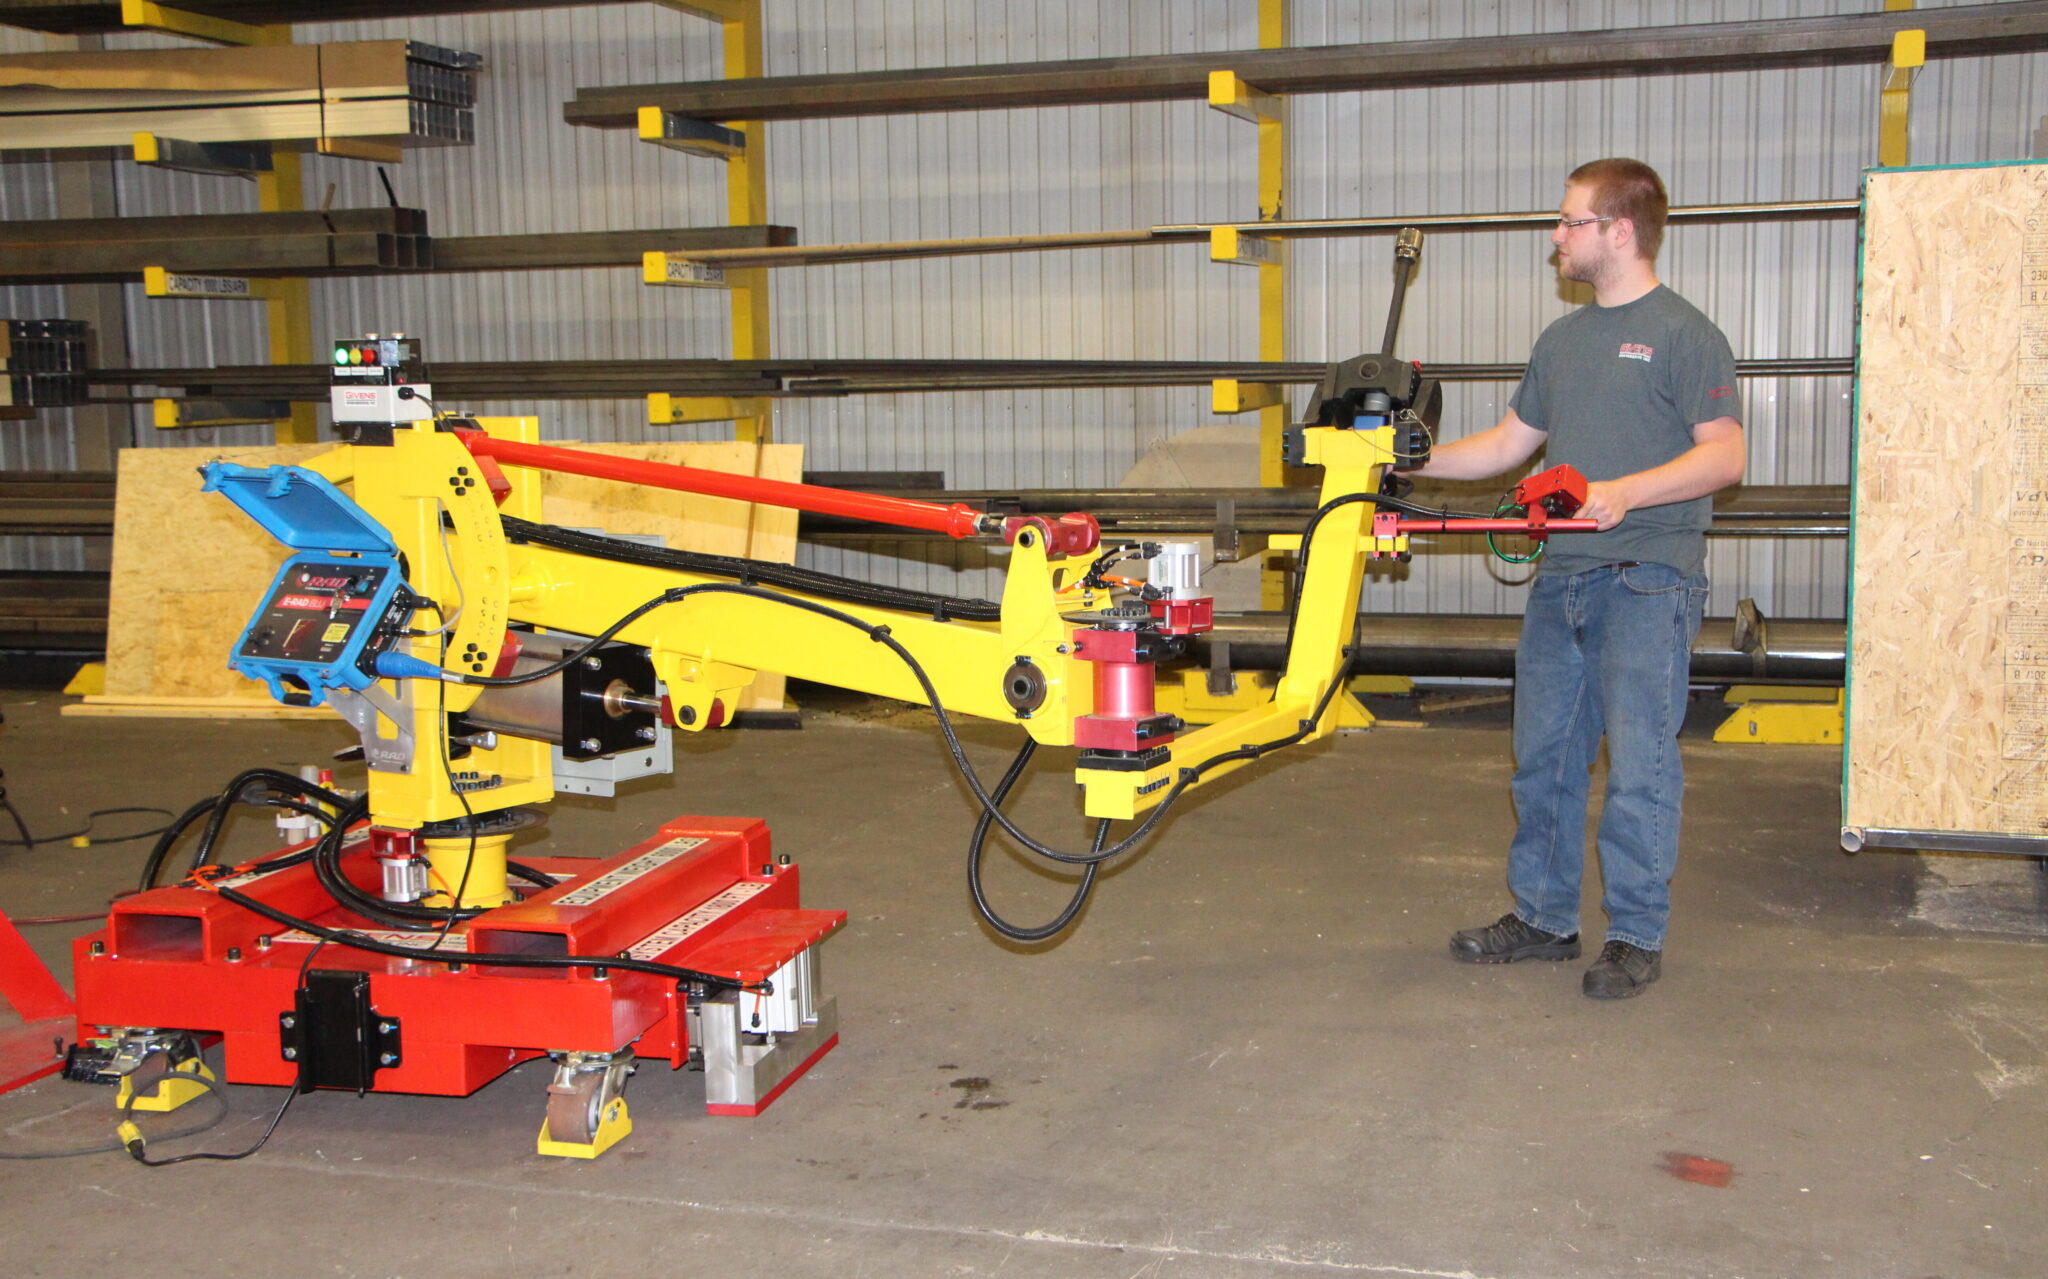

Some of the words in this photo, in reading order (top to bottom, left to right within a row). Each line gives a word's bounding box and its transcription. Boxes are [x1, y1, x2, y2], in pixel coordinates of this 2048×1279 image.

[168, 276, 202, 292] CAPACITY
[204, 278, 218, 293] 1000
[345, 391, 376, 399] GIVENS
[283, 597, 310, 607] E-RAD
[557, 872, 635, 905] EQUIPMENT
[661, 906, 723, 936] CAPACITY
